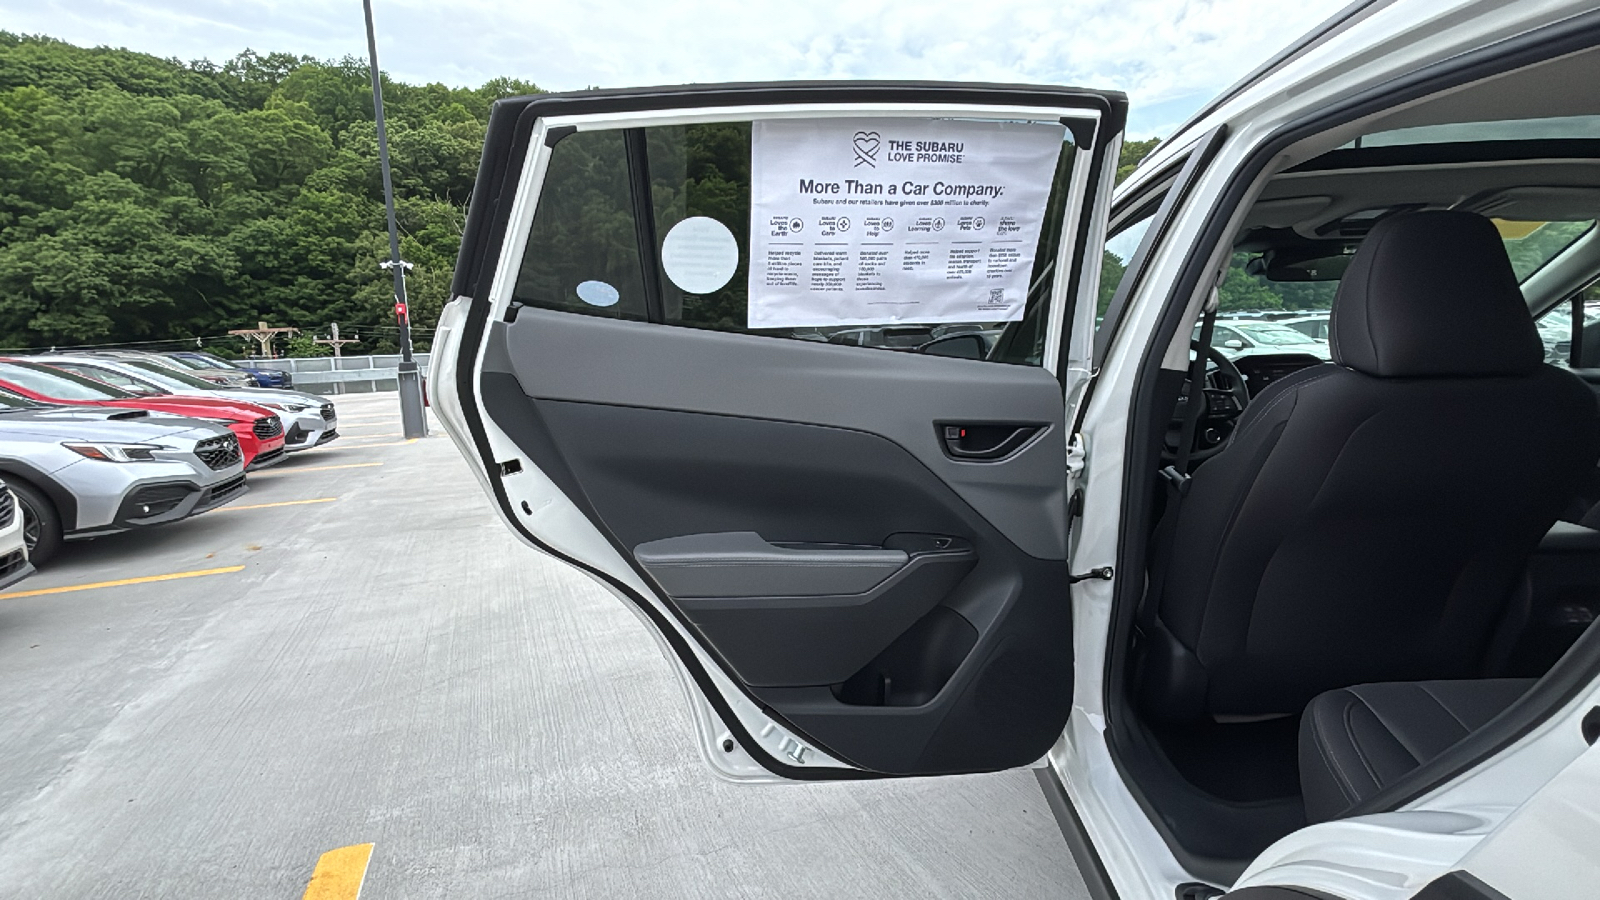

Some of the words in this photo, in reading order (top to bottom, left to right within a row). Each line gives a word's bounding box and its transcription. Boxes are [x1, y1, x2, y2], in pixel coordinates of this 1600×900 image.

[888, 140, 912, 151] THE
[916, 141, 964, 152] SUBARU
[888, 153, 913, 162] LOVE
[800, 179, 840, 194] More
[845, 180, 883, 194] Than
[888, 184, 897, 194] a
[902, 181, 928, 195] Car
